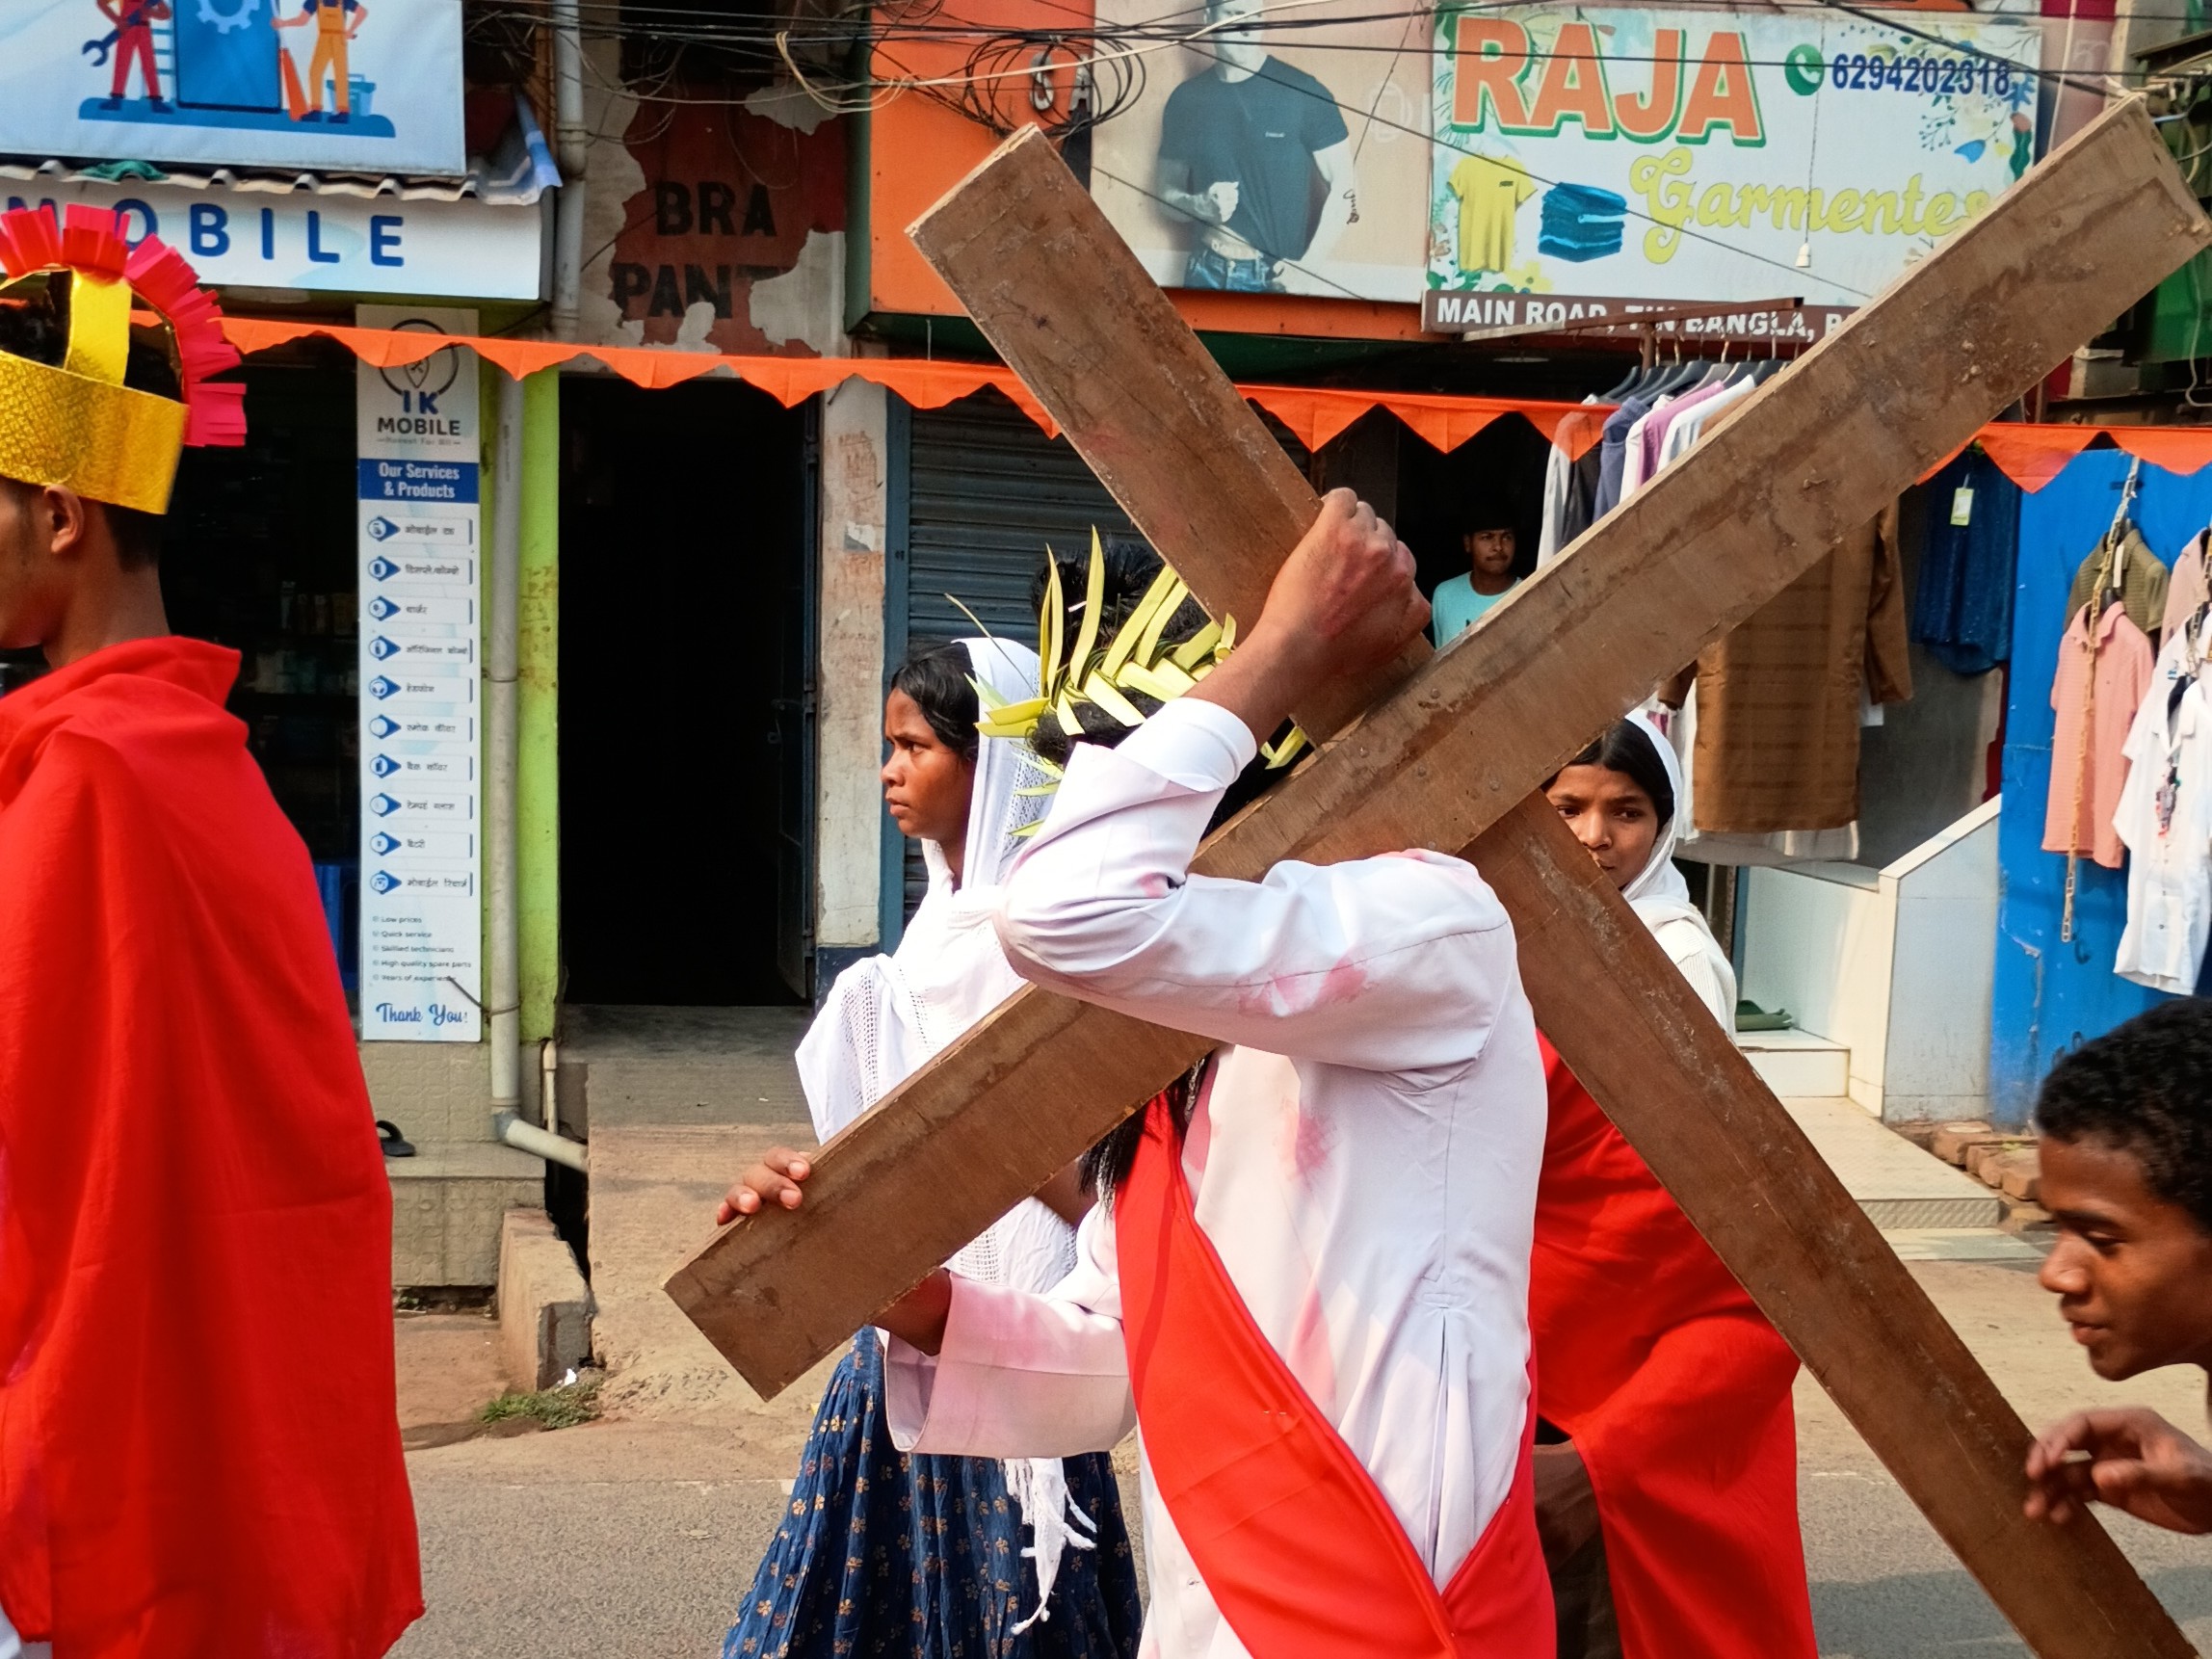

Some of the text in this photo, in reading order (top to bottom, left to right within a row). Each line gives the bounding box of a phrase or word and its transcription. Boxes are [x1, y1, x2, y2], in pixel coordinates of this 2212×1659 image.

[1451, 14, 1767, 148] RAJA
[1832, 53, 2011, 96] 6294202318
[655, 181, 777, 237] BRA
[1436, 298, 1515, 325] MAIN
[378, 417, 461, 435] MOBILE
[379, 462, 460, 480] Our Services
[383, 481, 456, 499] & Products
[376, 1002, 423, 1022] Thank
